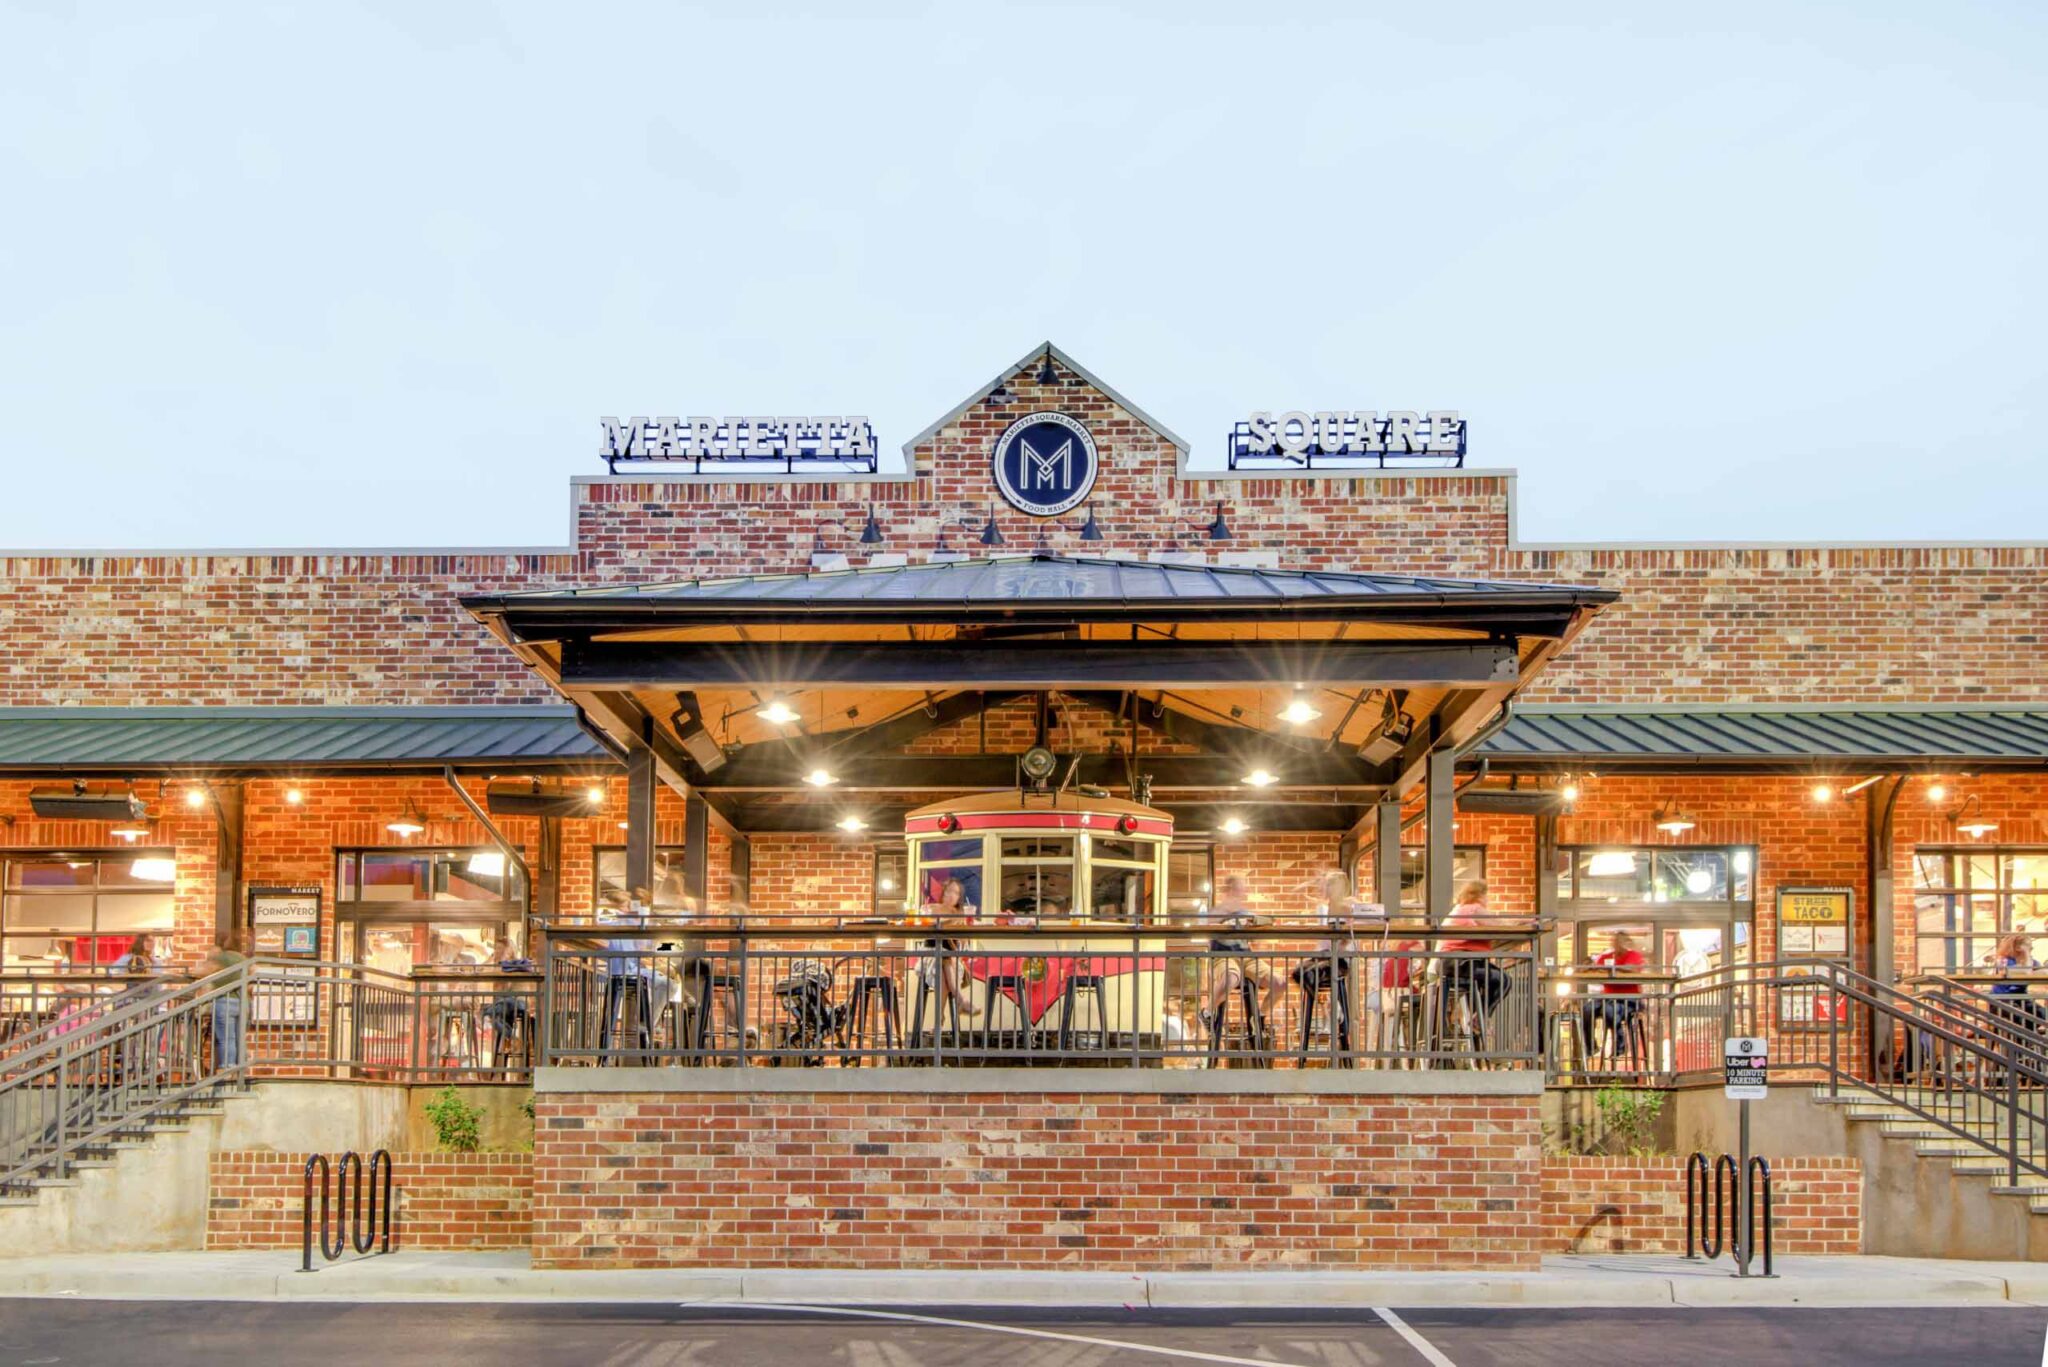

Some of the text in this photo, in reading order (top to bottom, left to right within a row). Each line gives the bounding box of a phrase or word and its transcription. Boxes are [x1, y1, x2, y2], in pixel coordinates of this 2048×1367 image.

[1002, 418, 1034, 445] MARIETTA
[1066, 419, 1091, 444] MARKET
[600, 411, 1458, 464] MARIETTA SQUARE
[1024, 503, 1068, 513] FOOD HALL
[1793, 897, 1833, 906] STREET
[1727, 1057, 1749, 1066] Uber
[1727, 1069, 1766, 1077] 10 MINUTE
[1729, 1077, 1763, 1085] PARKING
